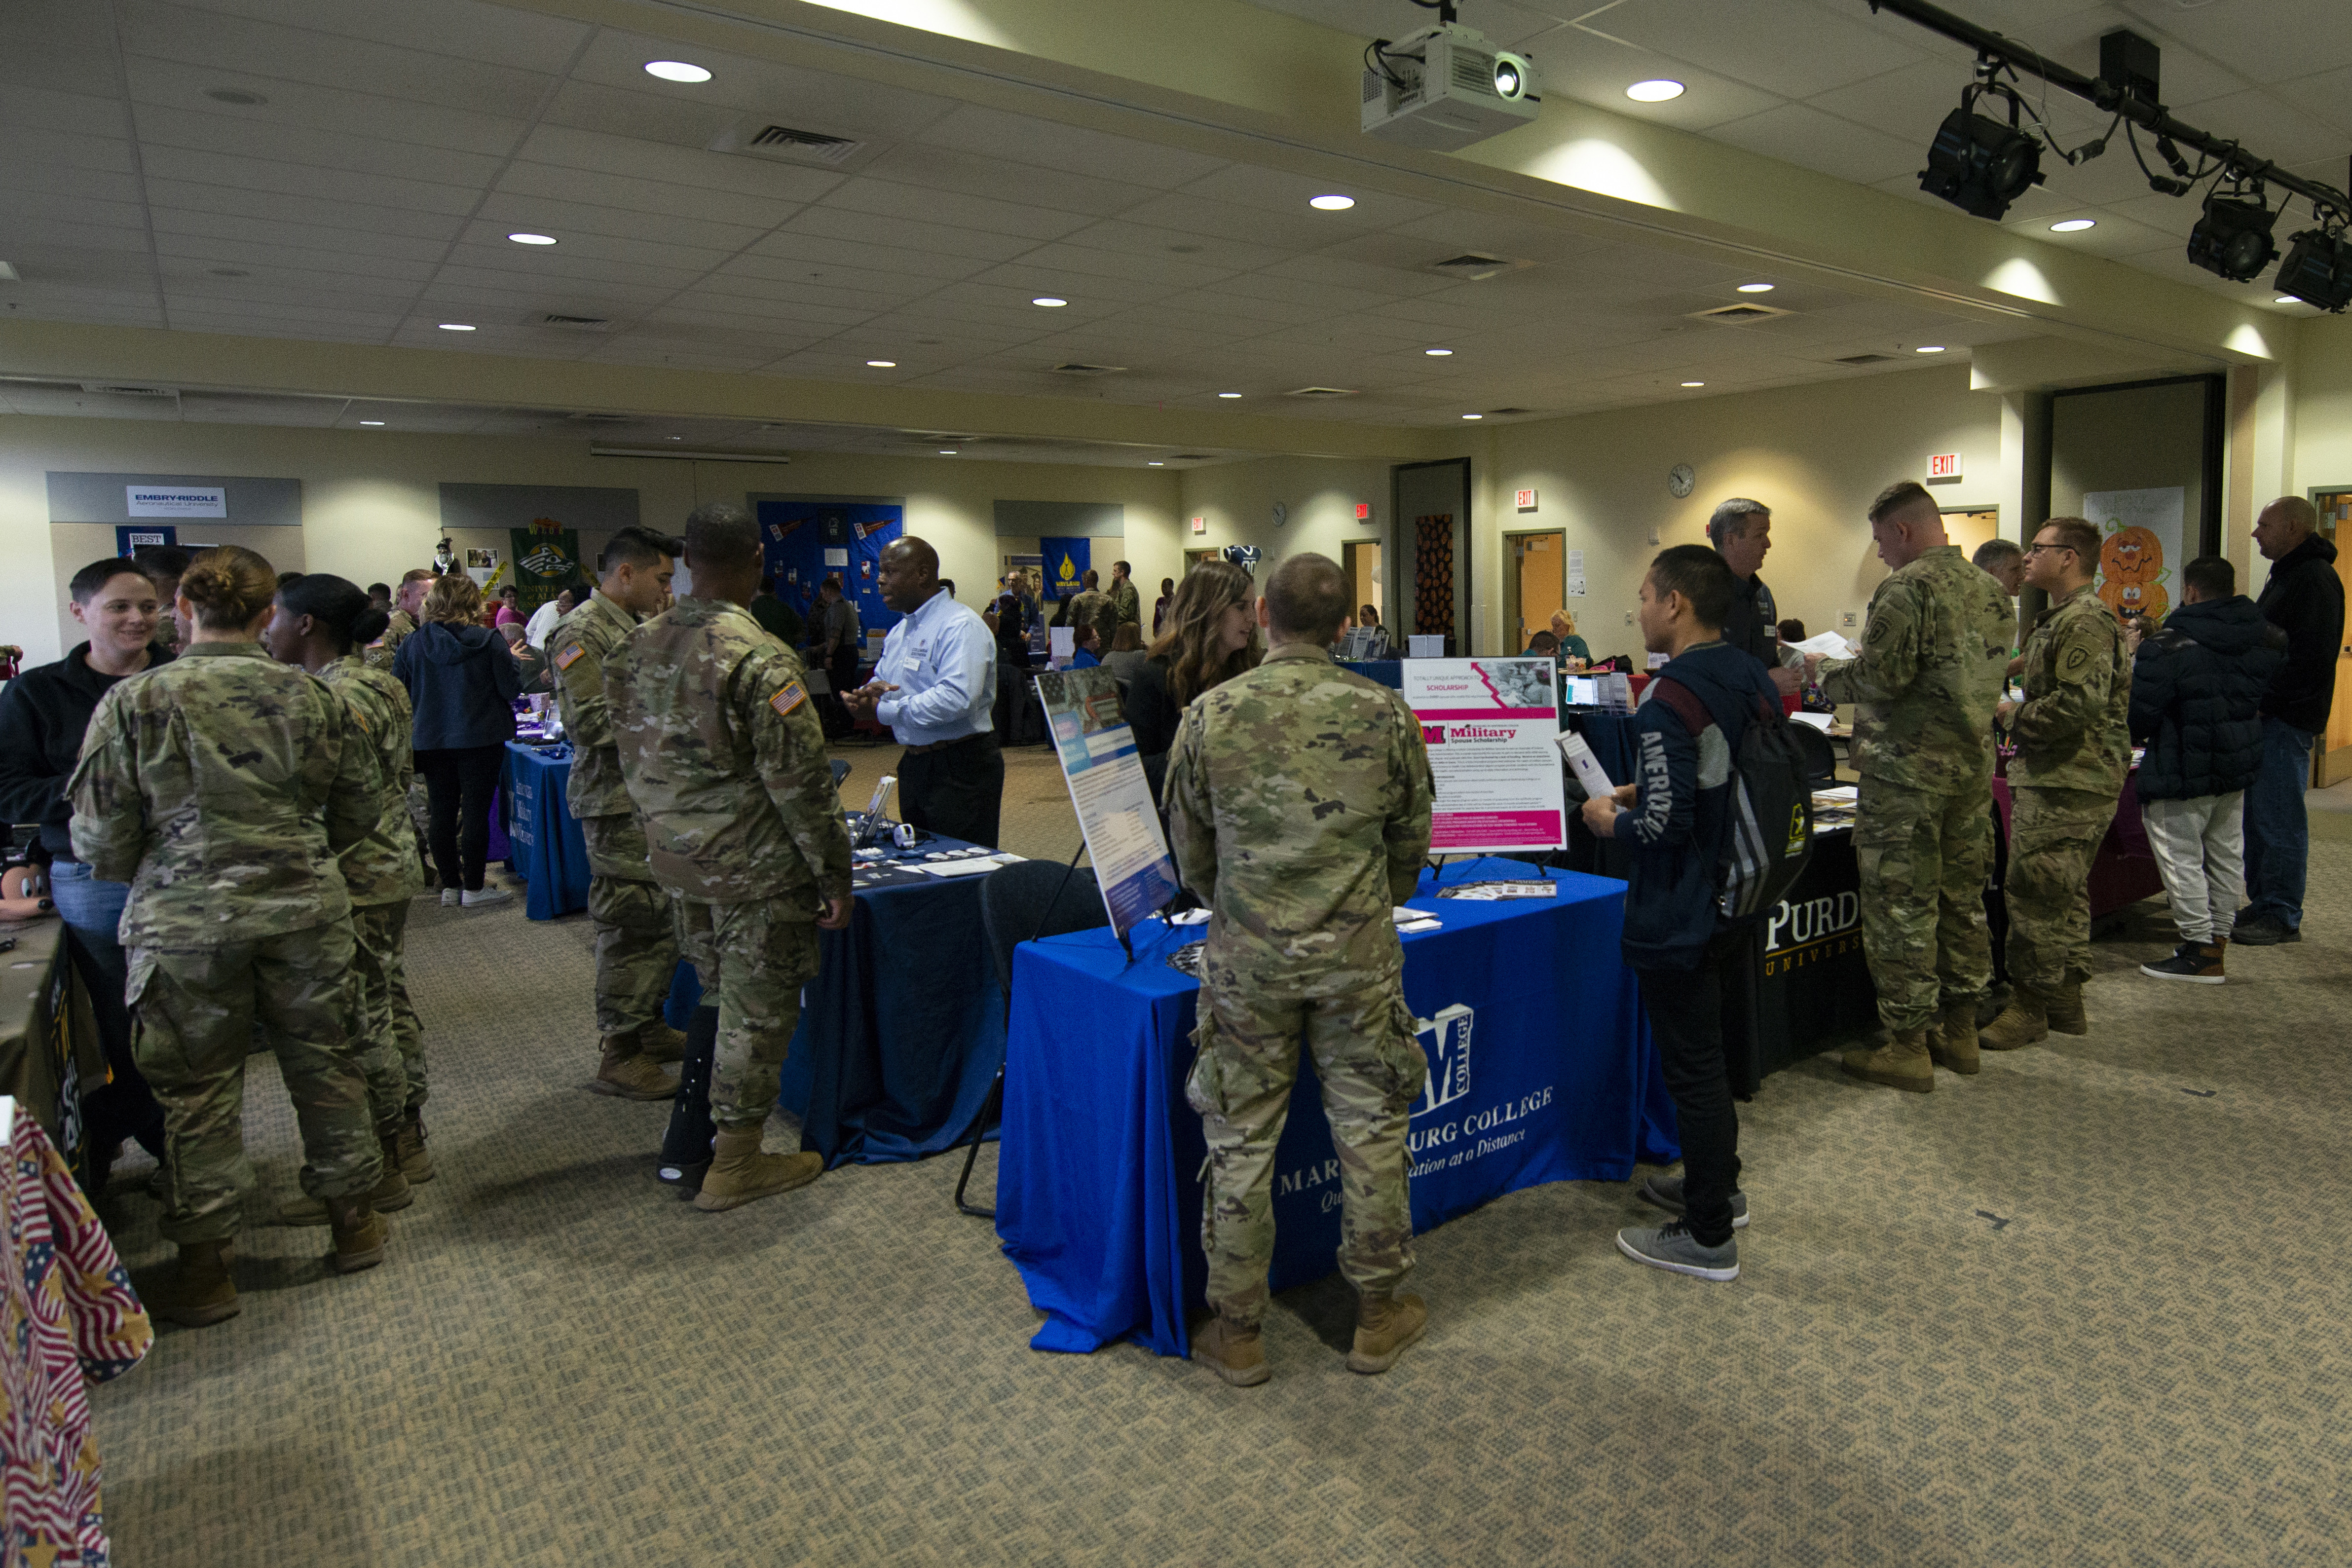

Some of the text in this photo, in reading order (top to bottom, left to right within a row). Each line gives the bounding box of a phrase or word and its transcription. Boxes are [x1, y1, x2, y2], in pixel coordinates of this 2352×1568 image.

[1933, 455, 1954, 475] EXIT
[1356, 503, 1368, 519] EXIT
[1518, 490, 1531, 506] EXIT
[132, 535, 161, 543] BEST
[1450, 727, 1517, 739] Military
[1765, 890, 1859, 952] PURD
[1765, 936, 1859, 976] UNIVERS
[1456, 1014, 1468, 1093] COLLEGE
[1464, 1086, 1553, 1135] COLLEGE
[1408, 1128, 1526, 1178] ation at a Distance
